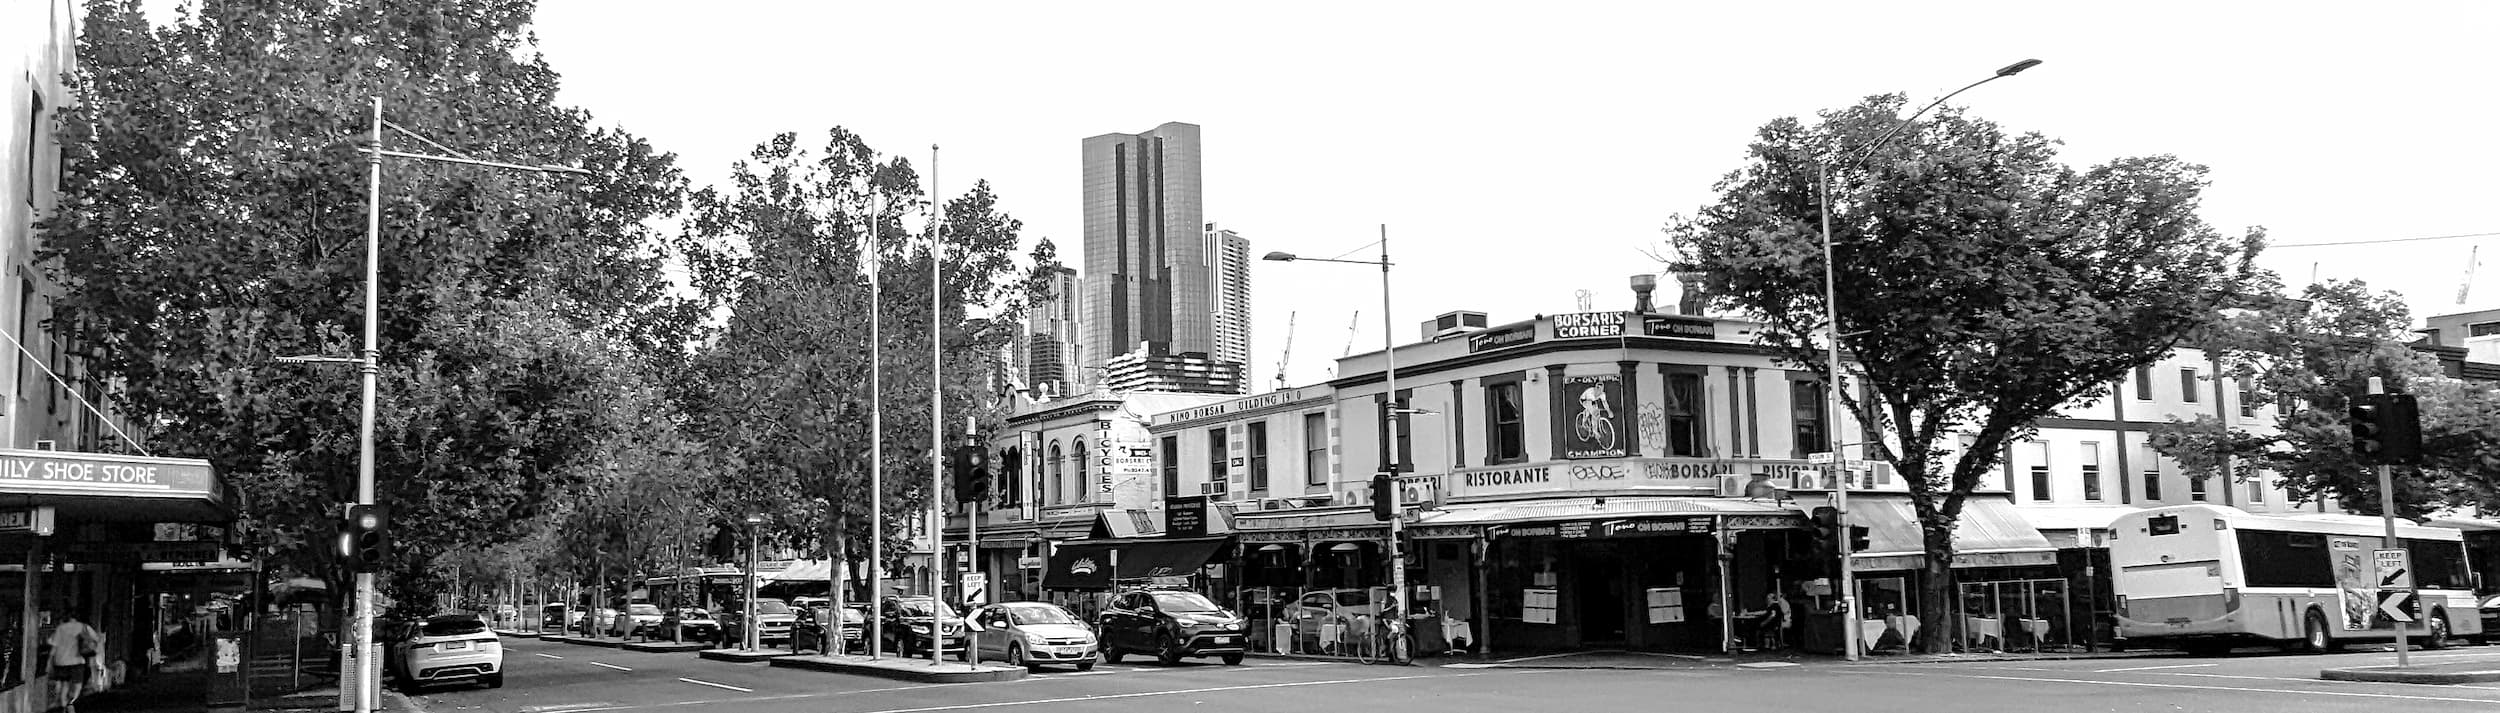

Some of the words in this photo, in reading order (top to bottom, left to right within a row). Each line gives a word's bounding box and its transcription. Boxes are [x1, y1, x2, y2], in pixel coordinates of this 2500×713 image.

[1554, 311, 1625, 326] BORSARI'S
[1558, 325, 1620, 337] CORNER
[1170, 411, 1190, 423] NINO
[1100, 421, 1112, 493] BICYCLES
[1567, 449, 1624, 458] CHAMPION
[0, 459, 34, 479] ILY
[43, 462, 94, 481] SHOE
[101, 465, 158, 484] STORE
[1466, 468, 1550, 488] RISTORANTE
[1671, 463, 1734, 480] BORSARI
[2379, 552, 2402, 560] KEEP
[2381, 560, 2401, 568] LEFT
